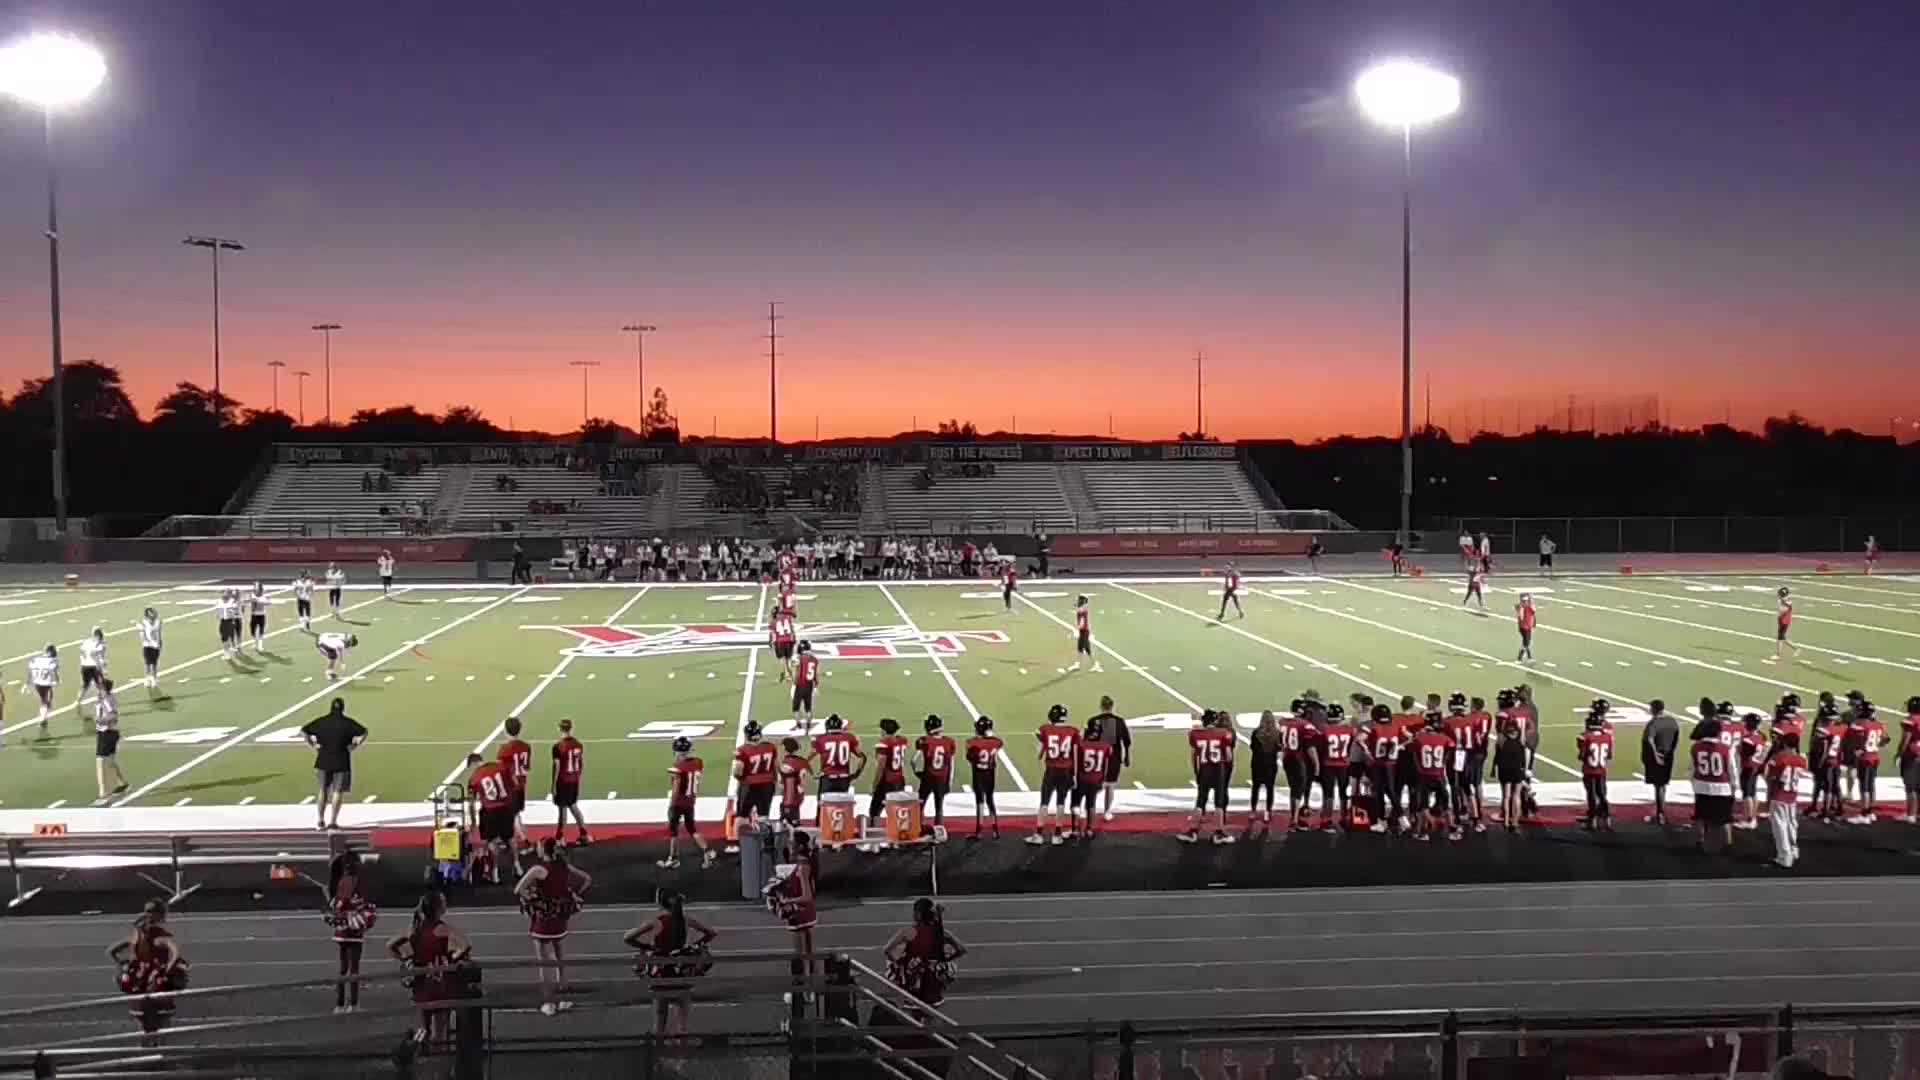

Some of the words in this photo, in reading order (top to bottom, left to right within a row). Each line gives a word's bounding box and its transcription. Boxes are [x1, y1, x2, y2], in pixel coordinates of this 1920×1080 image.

[775, 619, 791, 635] 44
[806, 662, 816, 680] 5
[824, 741, 850, 766] 70
[932, 745, 945, 770] 6
[1048, 735, 1072, 759] 54
[1196, 740, 1221, 763] 75
[1328, 733, 1350, 759] 27
[1421, 744, 1444, 769] 69
[750, 752, 773, 774] 77
[1083, 749, 1104, 772] 51
[1697, 751, 1723, 777] 50
[481, 772, 508, 801] 81
